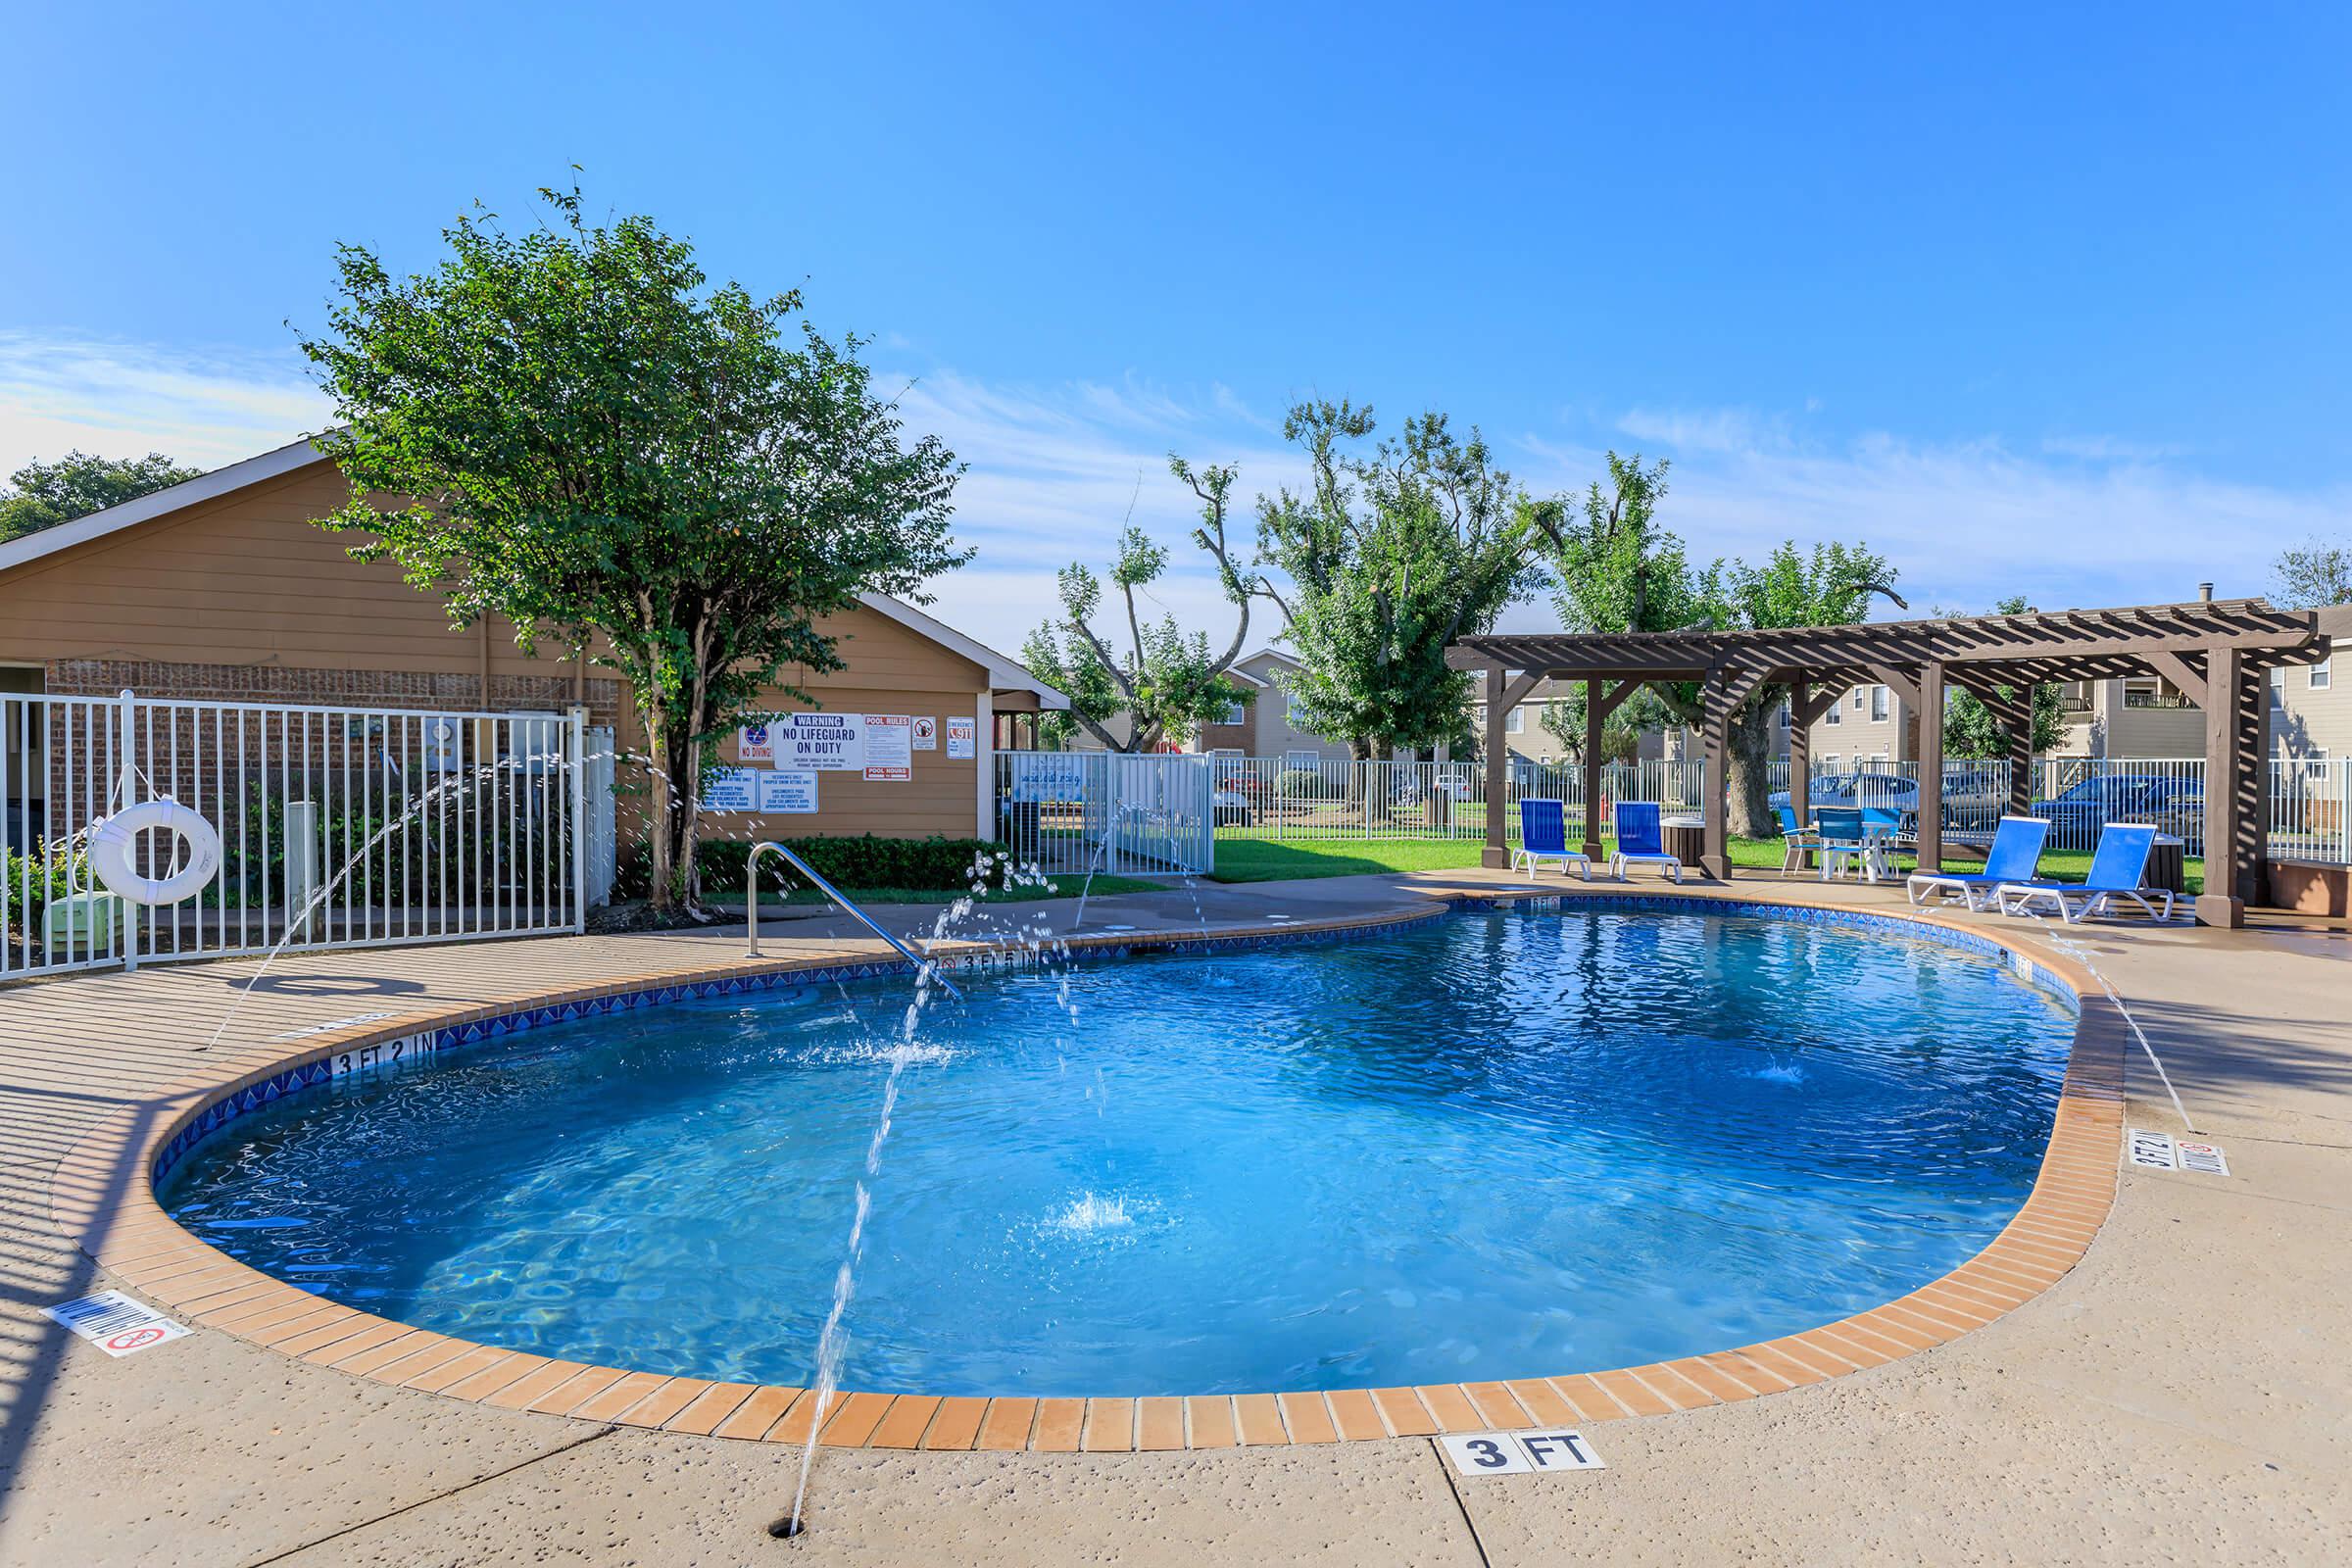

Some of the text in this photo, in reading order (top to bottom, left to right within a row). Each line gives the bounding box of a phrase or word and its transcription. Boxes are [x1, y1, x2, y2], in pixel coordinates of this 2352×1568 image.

[798, 716, 841, 725] WARNING
[783, 728, 855, 741] NO LIFEGUARD
[957, 728, 972, 739] 911
[742, 748, 750, 758] NO
[797, 742, 842, 754] ON DUTY
[964, 955, 974, 968] 3
[339, 1032, 432, 1074] 3 FT 2 IN
[2135, 1140, 2169, 1149] 2
[2134, 1147, 2171, 1160] FT
[2135, 1157, 2171, 1167] 3
[1466, 1435, 1588, 1468] 3 FT
